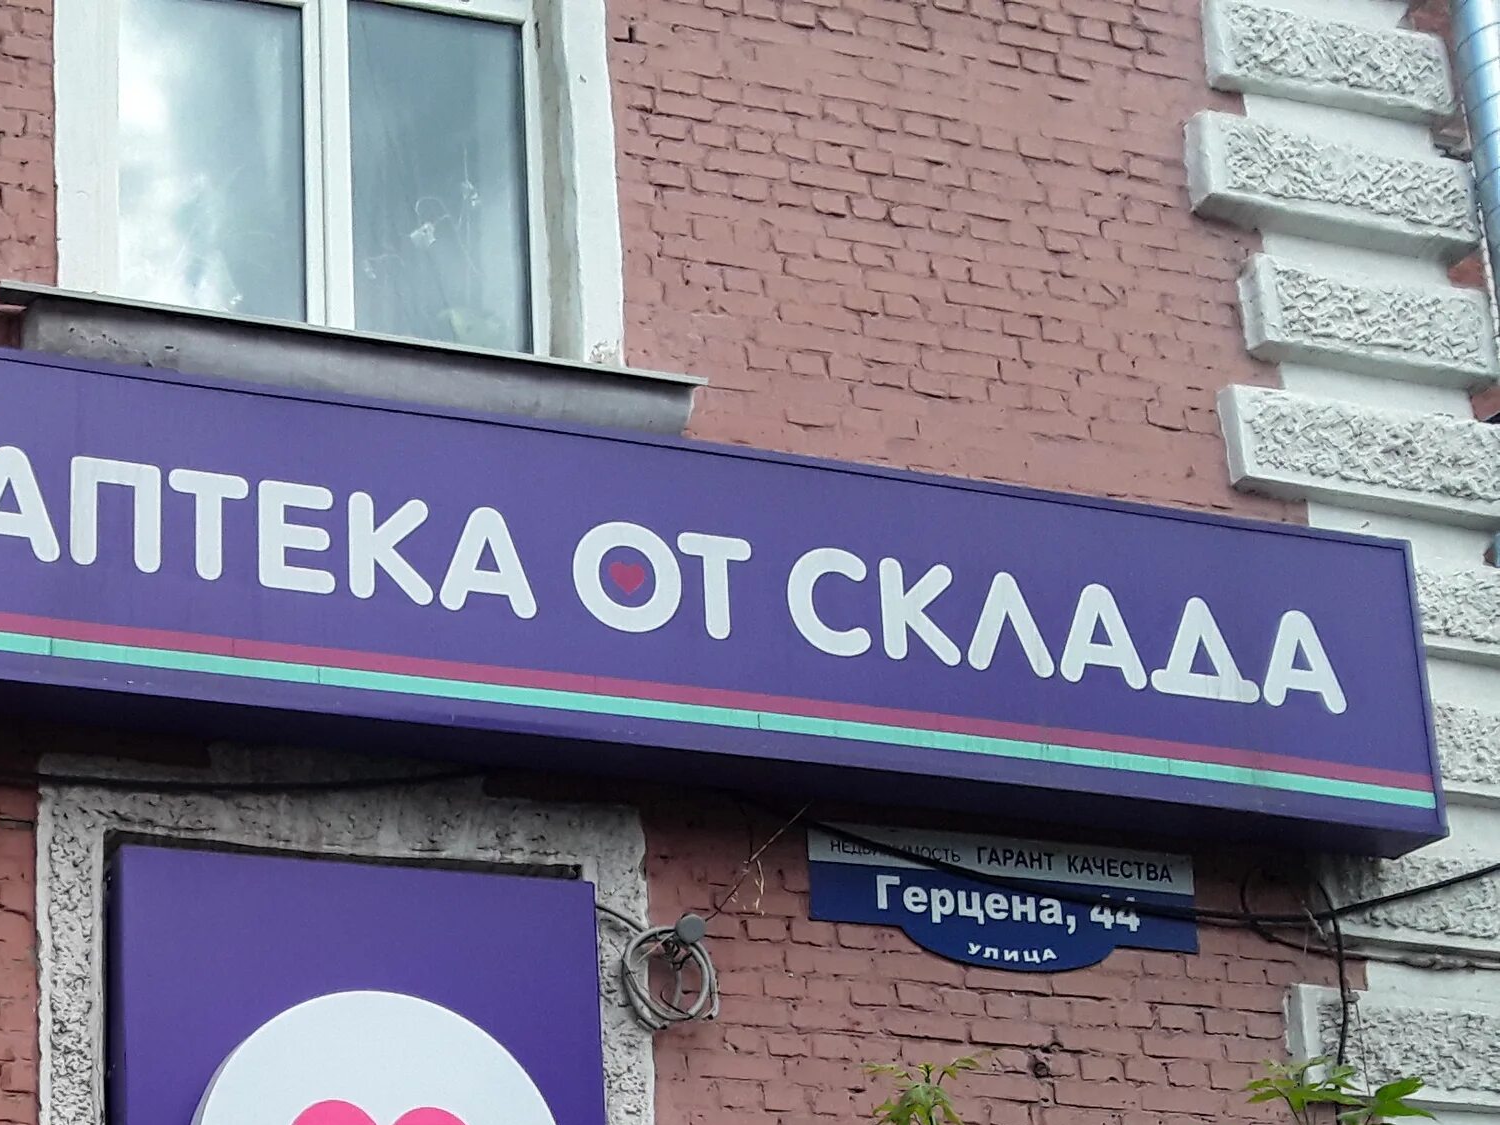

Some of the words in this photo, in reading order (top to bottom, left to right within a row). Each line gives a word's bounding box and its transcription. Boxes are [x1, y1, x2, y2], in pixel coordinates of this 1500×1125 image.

[571, 520, 754, 642] ОТ
[786, 546, 1349, 716] СКЛАДА
[976, 846, 1055, 872] ГАРАНТ
[1067, 854, 1173, 884] КАЧЕСТВА
[875, 874, 1077, 935] Герцена,
[1089, 893, 1141, 932] 44
